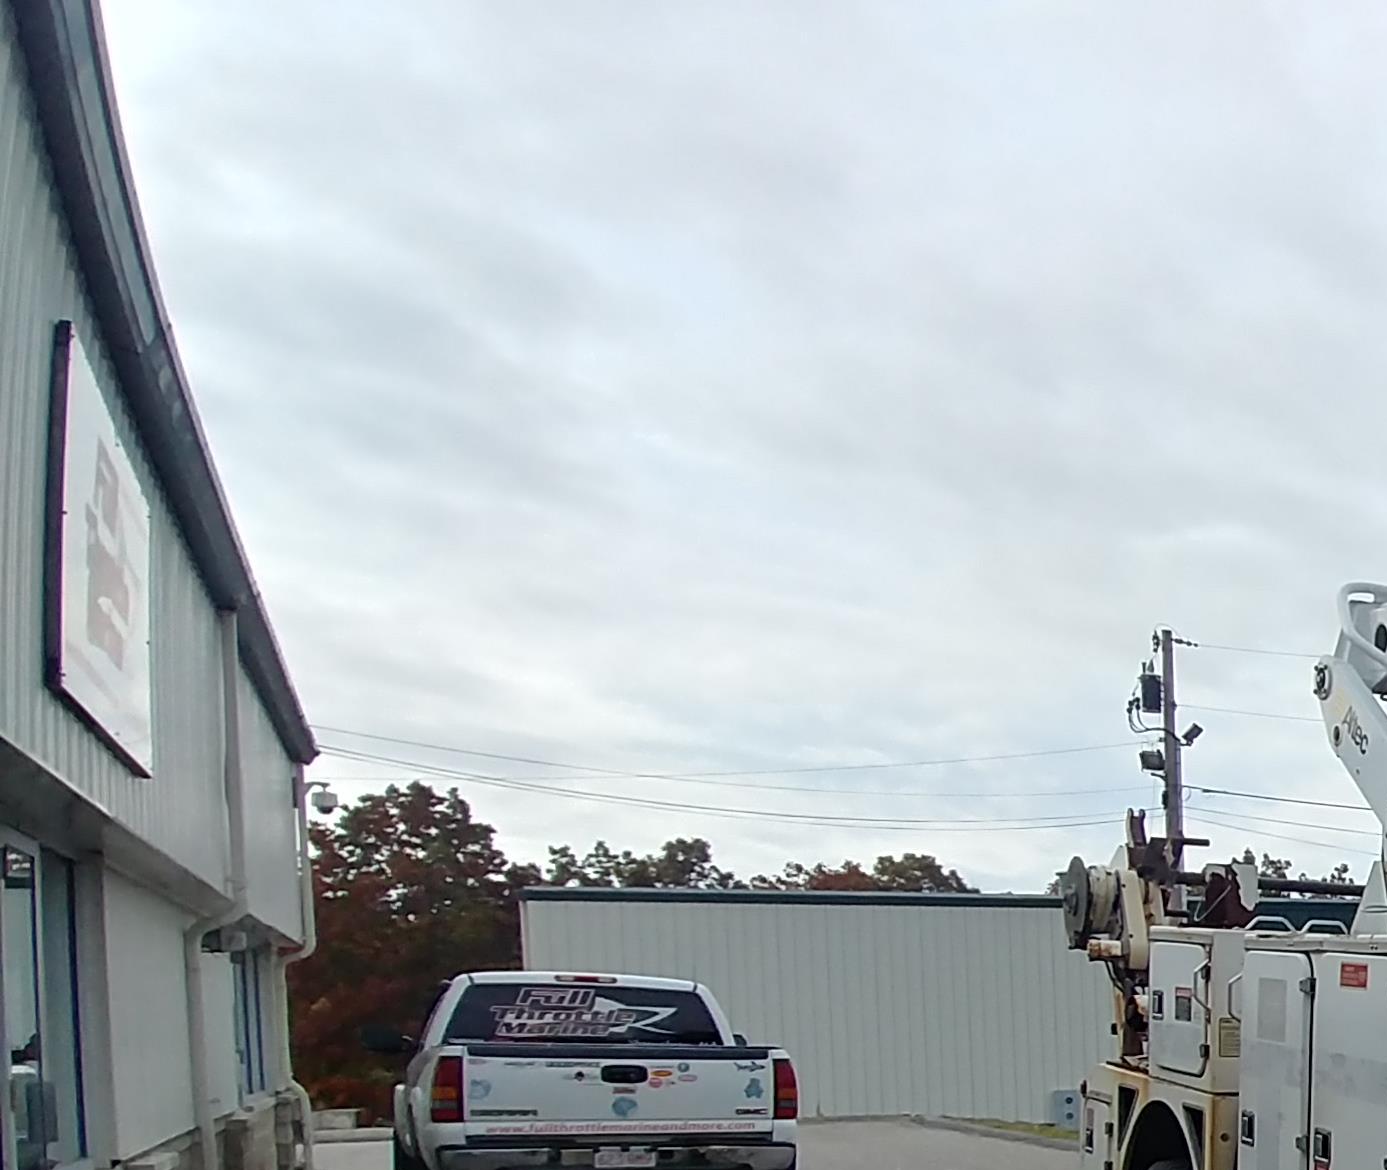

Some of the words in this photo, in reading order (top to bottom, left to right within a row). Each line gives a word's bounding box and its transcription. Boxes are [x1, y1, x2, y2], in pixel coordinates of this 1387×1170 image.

[1341, 705, 1369, 755] Altec
[515, 987, 596, 1007] Full
[490, 1005, 636, 1024] Throttle
[495, 1021, 611, 1037] Marine
[485, 1121, 756, 1134] www.fullthrottlemarineandmore.com
